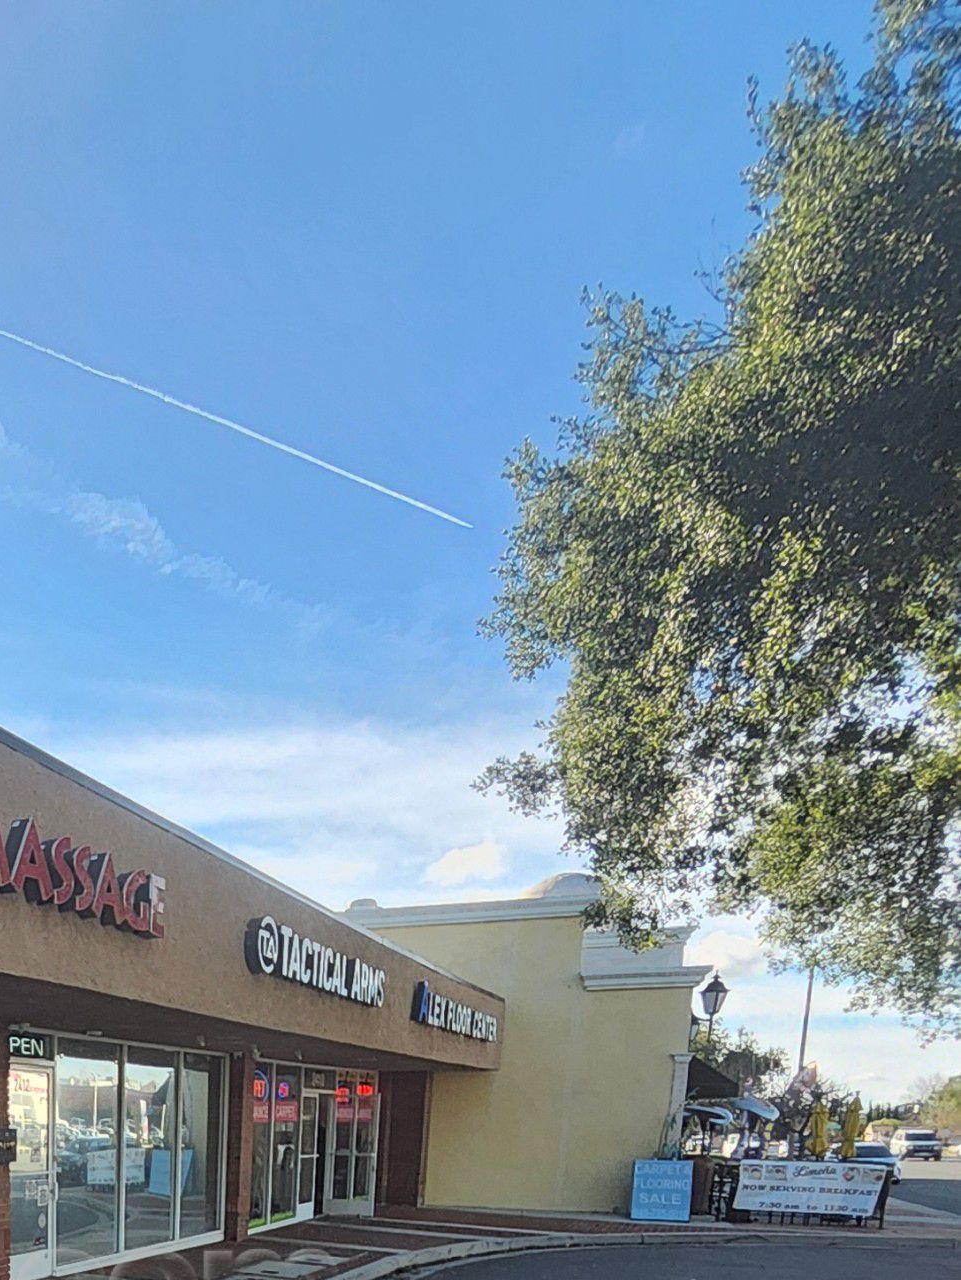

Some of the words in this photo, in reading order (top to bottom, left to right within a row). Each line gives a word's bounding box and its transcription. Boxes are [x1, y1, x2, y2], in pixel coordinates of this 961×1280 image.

[280, 924, 348, 997] TACTICAL
[350, 957, 386, 1008] ARMS
[418, 980, 447, 1029] ALEX
[446, 999, 472, 1036] FLOOR
[472, 1009, 497, 1042] CENTER
[8, 1036, 44, 1057] PEN
[638, 1192, 682, 1205] SALE
[741, 1184, 767, 1192] NOW
[769, 1184, 816, 1194] SERVING
[818, 1187, 879, 1197] BREAKFAST
